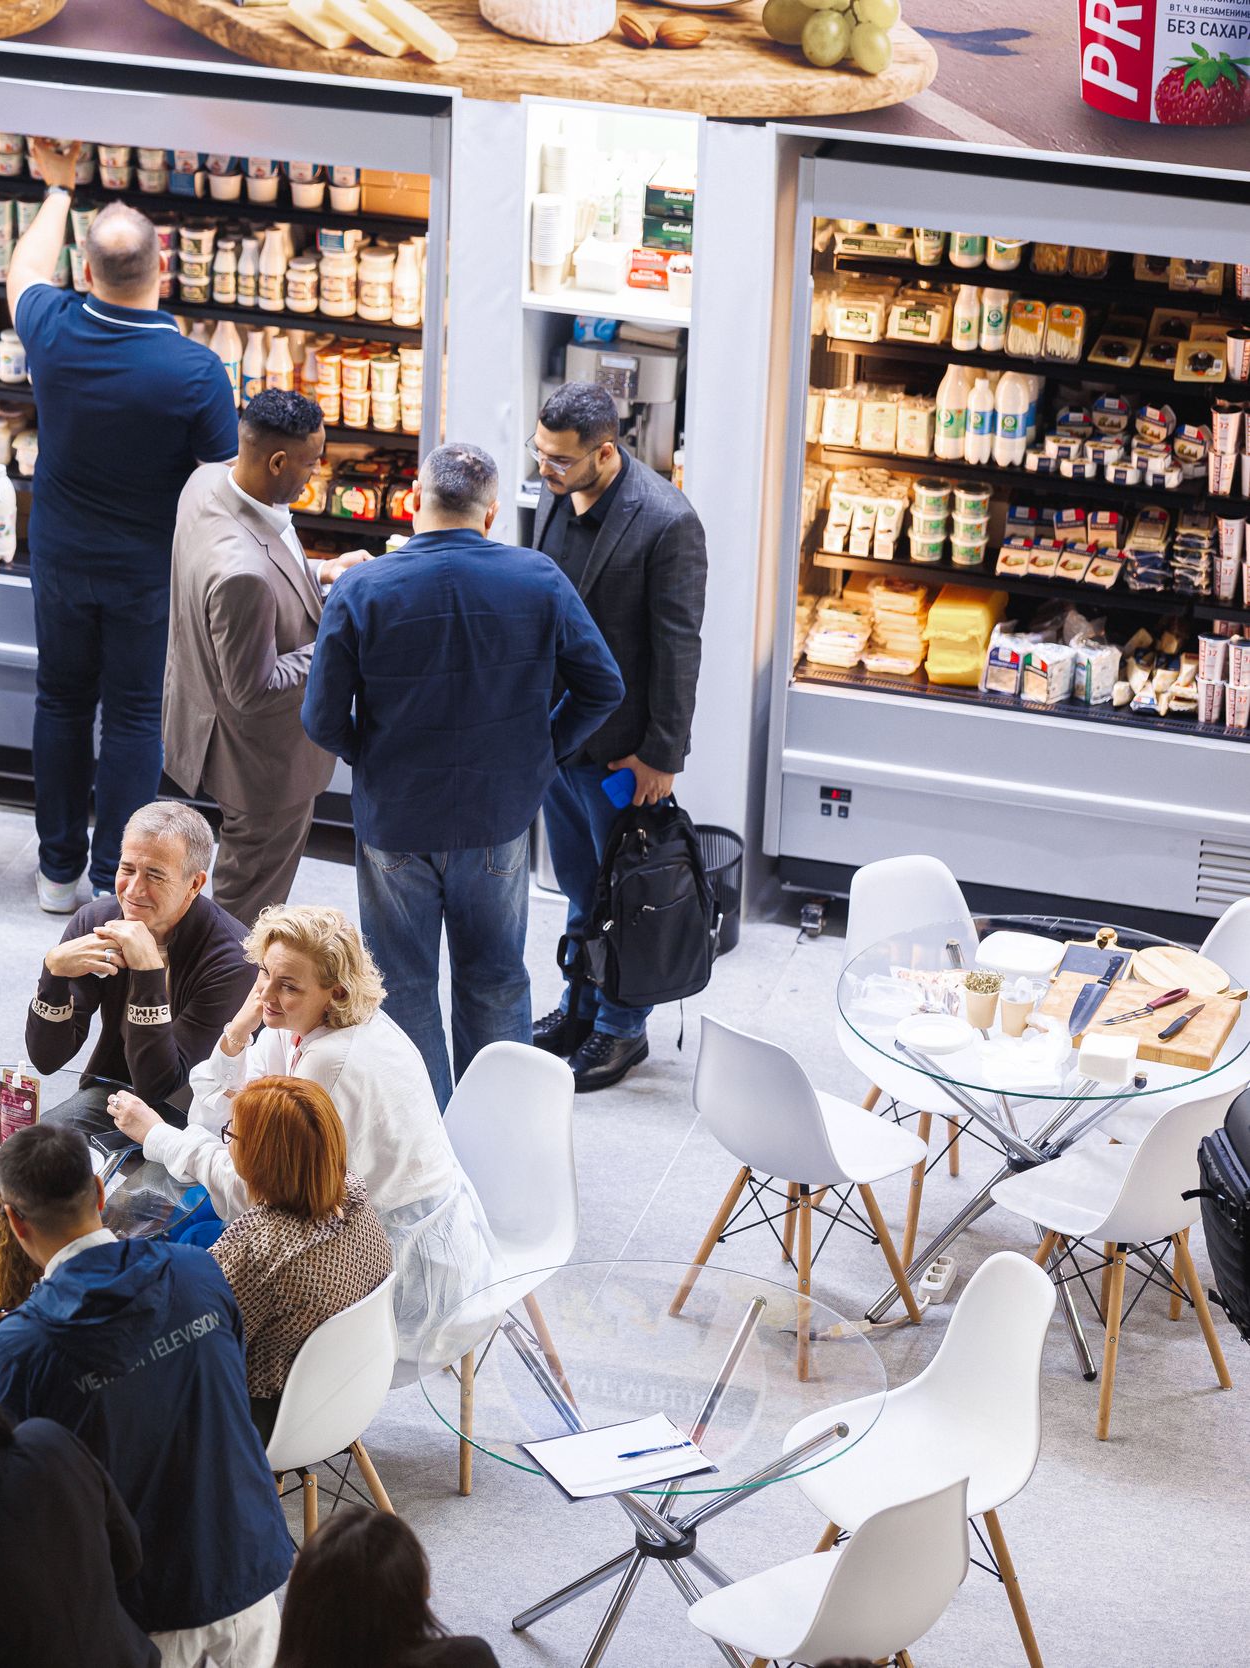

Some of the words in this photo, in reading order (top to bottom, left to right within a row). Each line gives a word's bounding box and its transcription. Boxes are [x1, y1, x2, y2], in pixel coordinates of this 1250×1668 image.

[1167, 18, 1196, 35] БЕЗ
[1200, 21, 1250, 40] САХАР
[132, 1016, 159, 1024] JOHN
